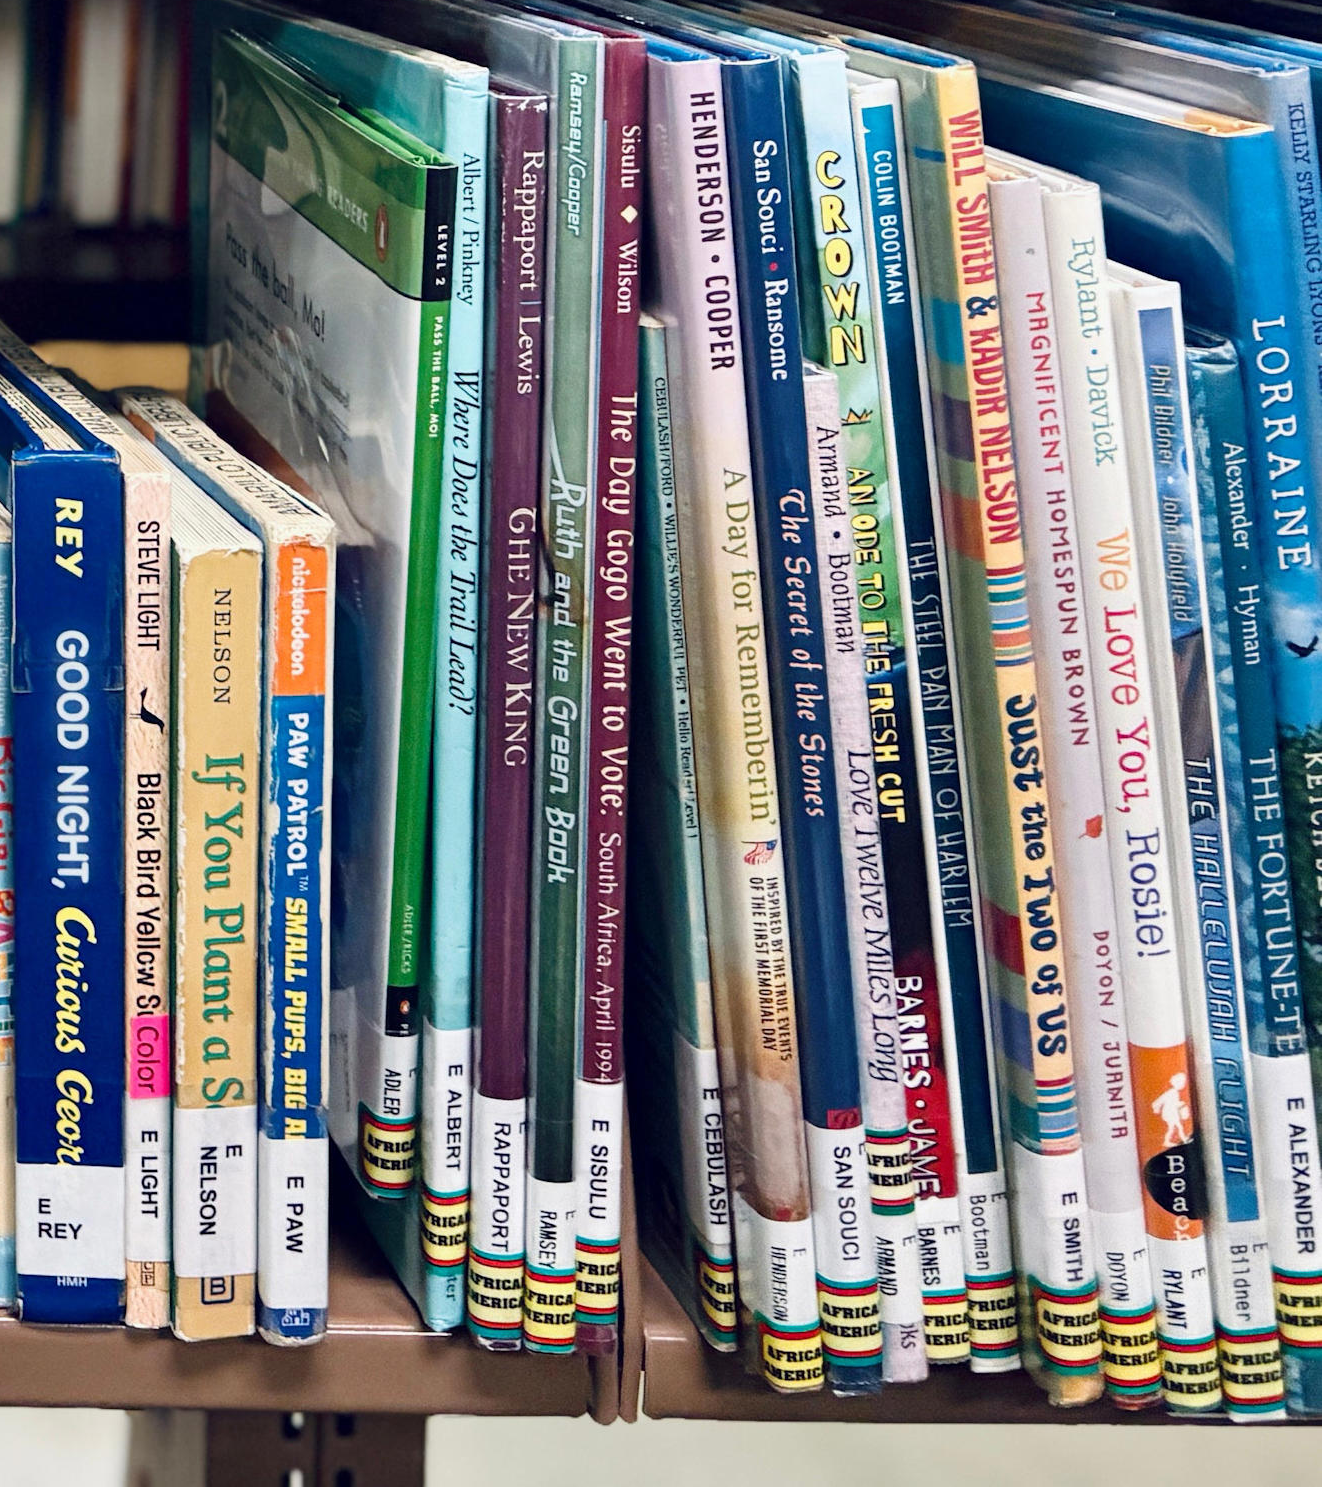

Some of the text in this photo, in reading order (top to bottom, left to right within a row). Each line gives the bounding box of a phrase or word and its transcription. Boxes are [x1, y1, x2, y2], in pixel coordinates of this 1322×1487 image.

[456, 152, 481, 306] Albert Pinkney
[566, 72, 587, 236] Ramsey/Cooper
[615, 125, 637, 314] Sisulu Wilson
[691, 92, 736, 372] HENDERSON COOPER
[872, 149, 905, 306] COLIN BOOTMAN
[513, 149, 546, 396] Rappaport Lewis
[753, 141, 787, 381] San Souci Ransome
[817, 151, 864, 365] CROWN
[55, 497, 84, 578] REY
[977, 425, 1020, 545] NELSON
[1026, 292, 1089, 746] MAGNIFICENT HOMESPUN BROWN
[1251, 316, 1313, 570] LORRAINE
[137, 520, 160, 651] STEVE LIGHT
[448, 372, 480, 716] Where Does the Trail Lead?
[213, 589, 232, 705] NELSON
[599, 528, 633, 817] Gogo Went to Vote:
[52, 630, 90, 890] GOOD NIGHT,
[1096, 527, 1172, 959] We Love You, Rosie!
[193, 753, 245, 1024] If You Plant
[199, 1146, 216, 1236] NELSON
[590, 1152, 608, 1220] SISULU
[1063, 1218, 1083, 1282] SMITH
[1287, 1125, 1316, 1255] ALEXANDER
